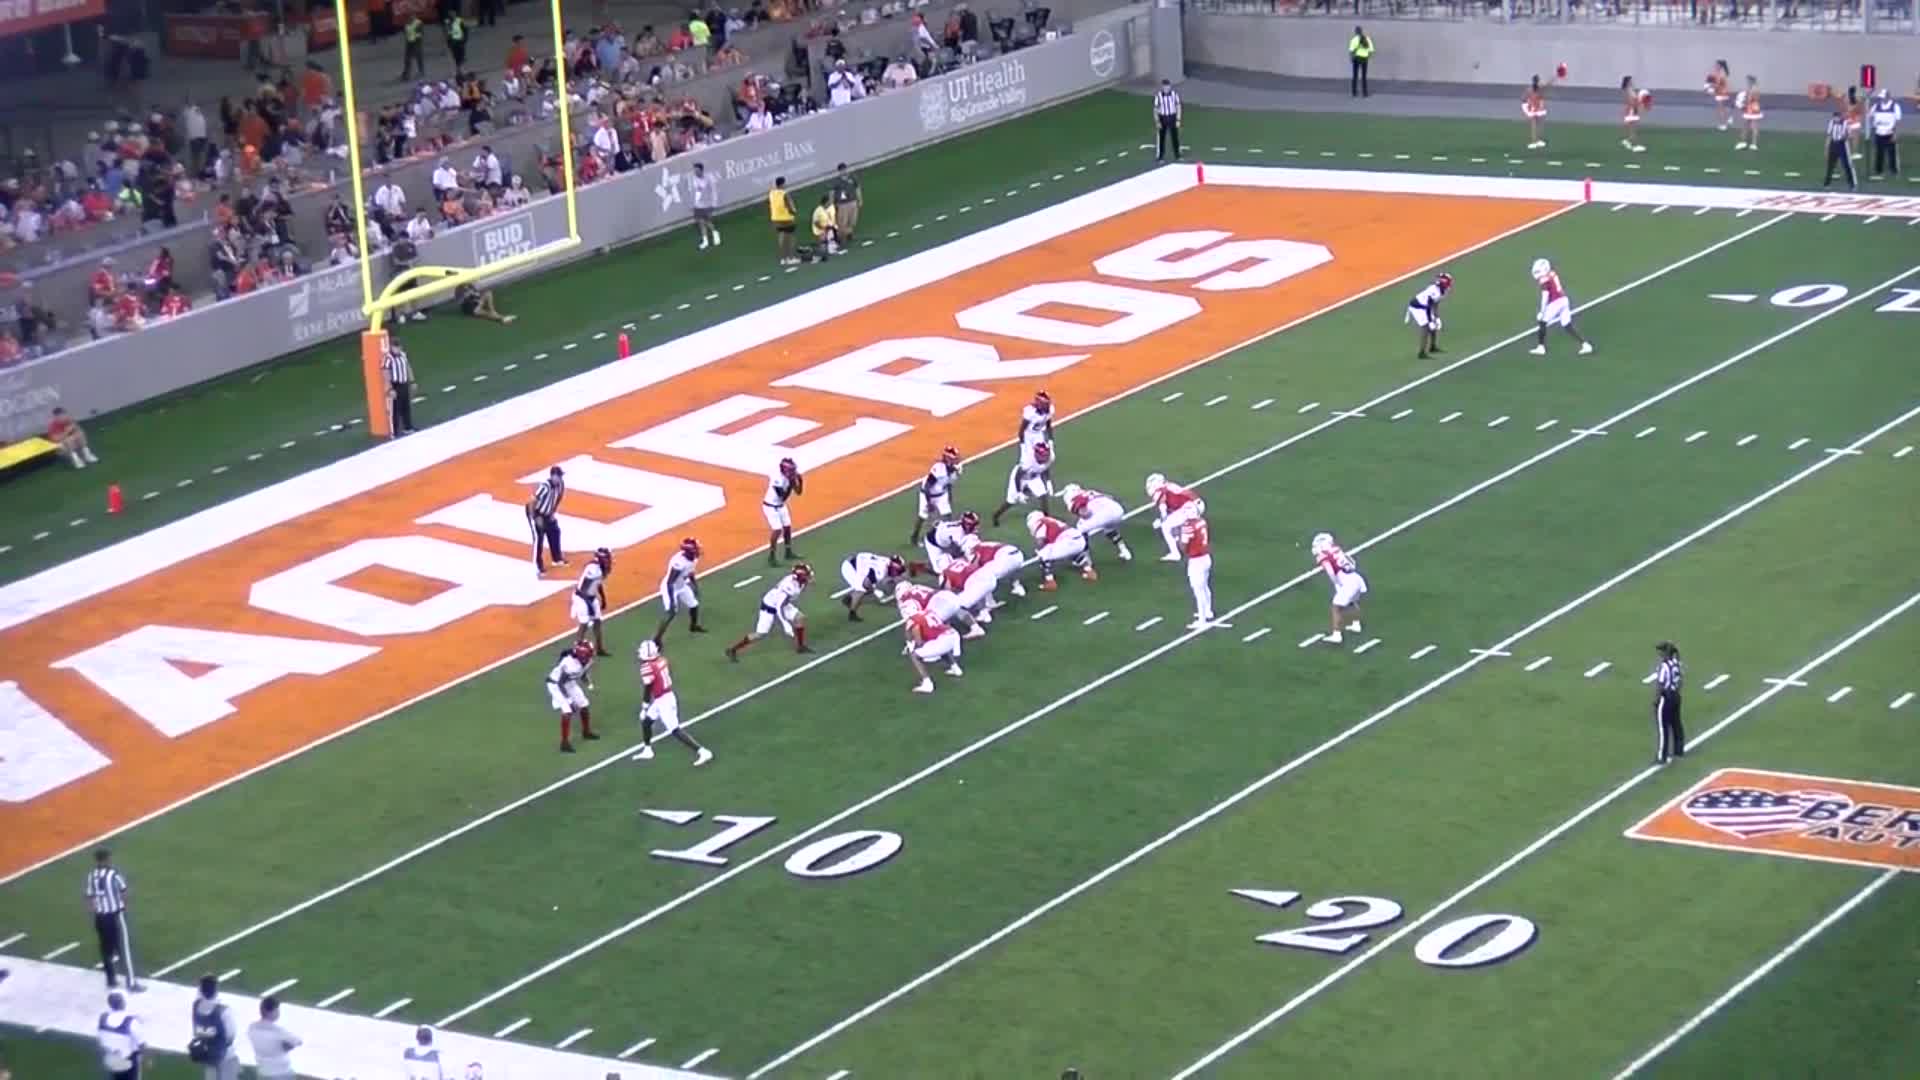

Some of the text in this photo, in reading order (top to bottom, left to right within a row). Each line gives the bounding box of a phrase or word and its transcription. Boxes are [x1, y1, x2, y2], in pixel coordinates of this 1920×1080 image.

[948, 60, 1025, 102] UT Health
[484, 222, 523, 253] BUD
